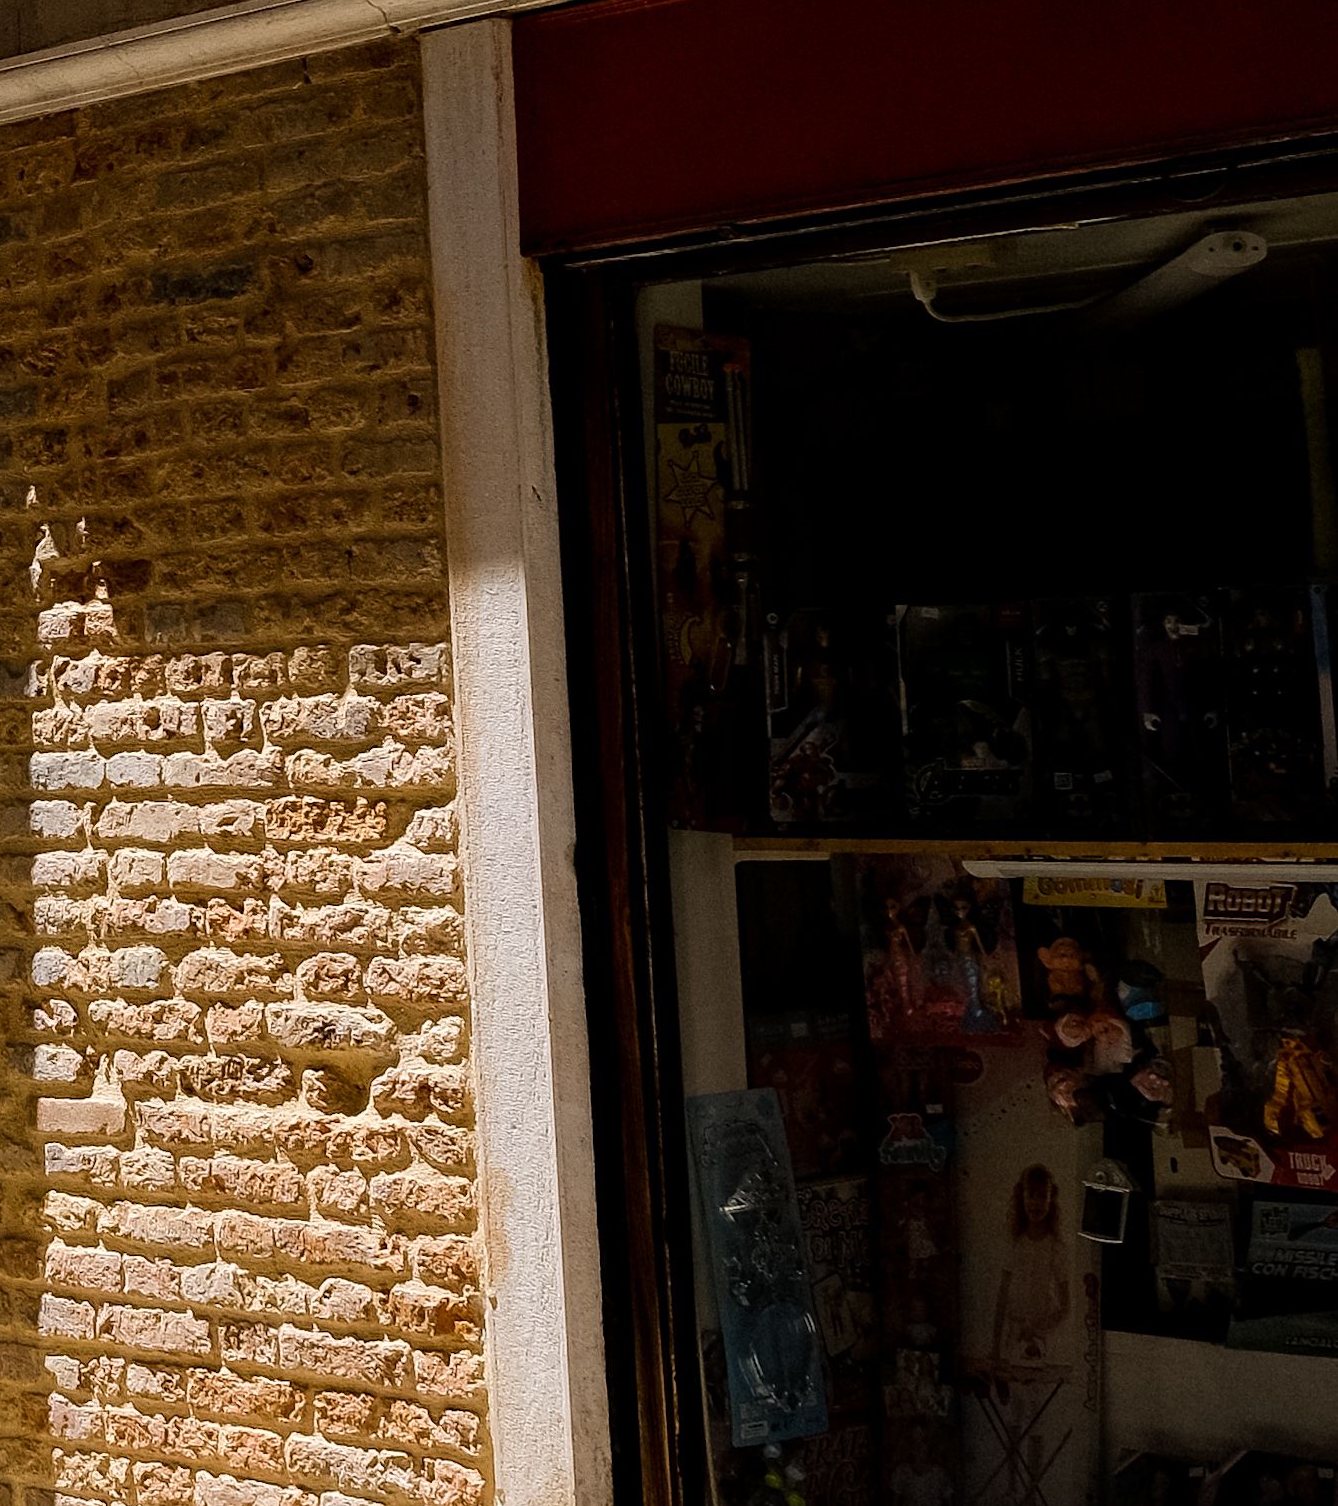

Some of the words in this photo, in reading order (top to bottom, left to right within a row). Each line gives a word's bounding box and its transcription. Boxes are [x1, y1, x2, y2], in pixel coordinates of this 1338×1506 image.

[664, 372, 716, 401] COWBOY
[1206, 883, 1293, 916] ROBOT
[1287, 1151, 1327, 1172] TRUCK
[1251, 1261, 1289, 1277] CON
